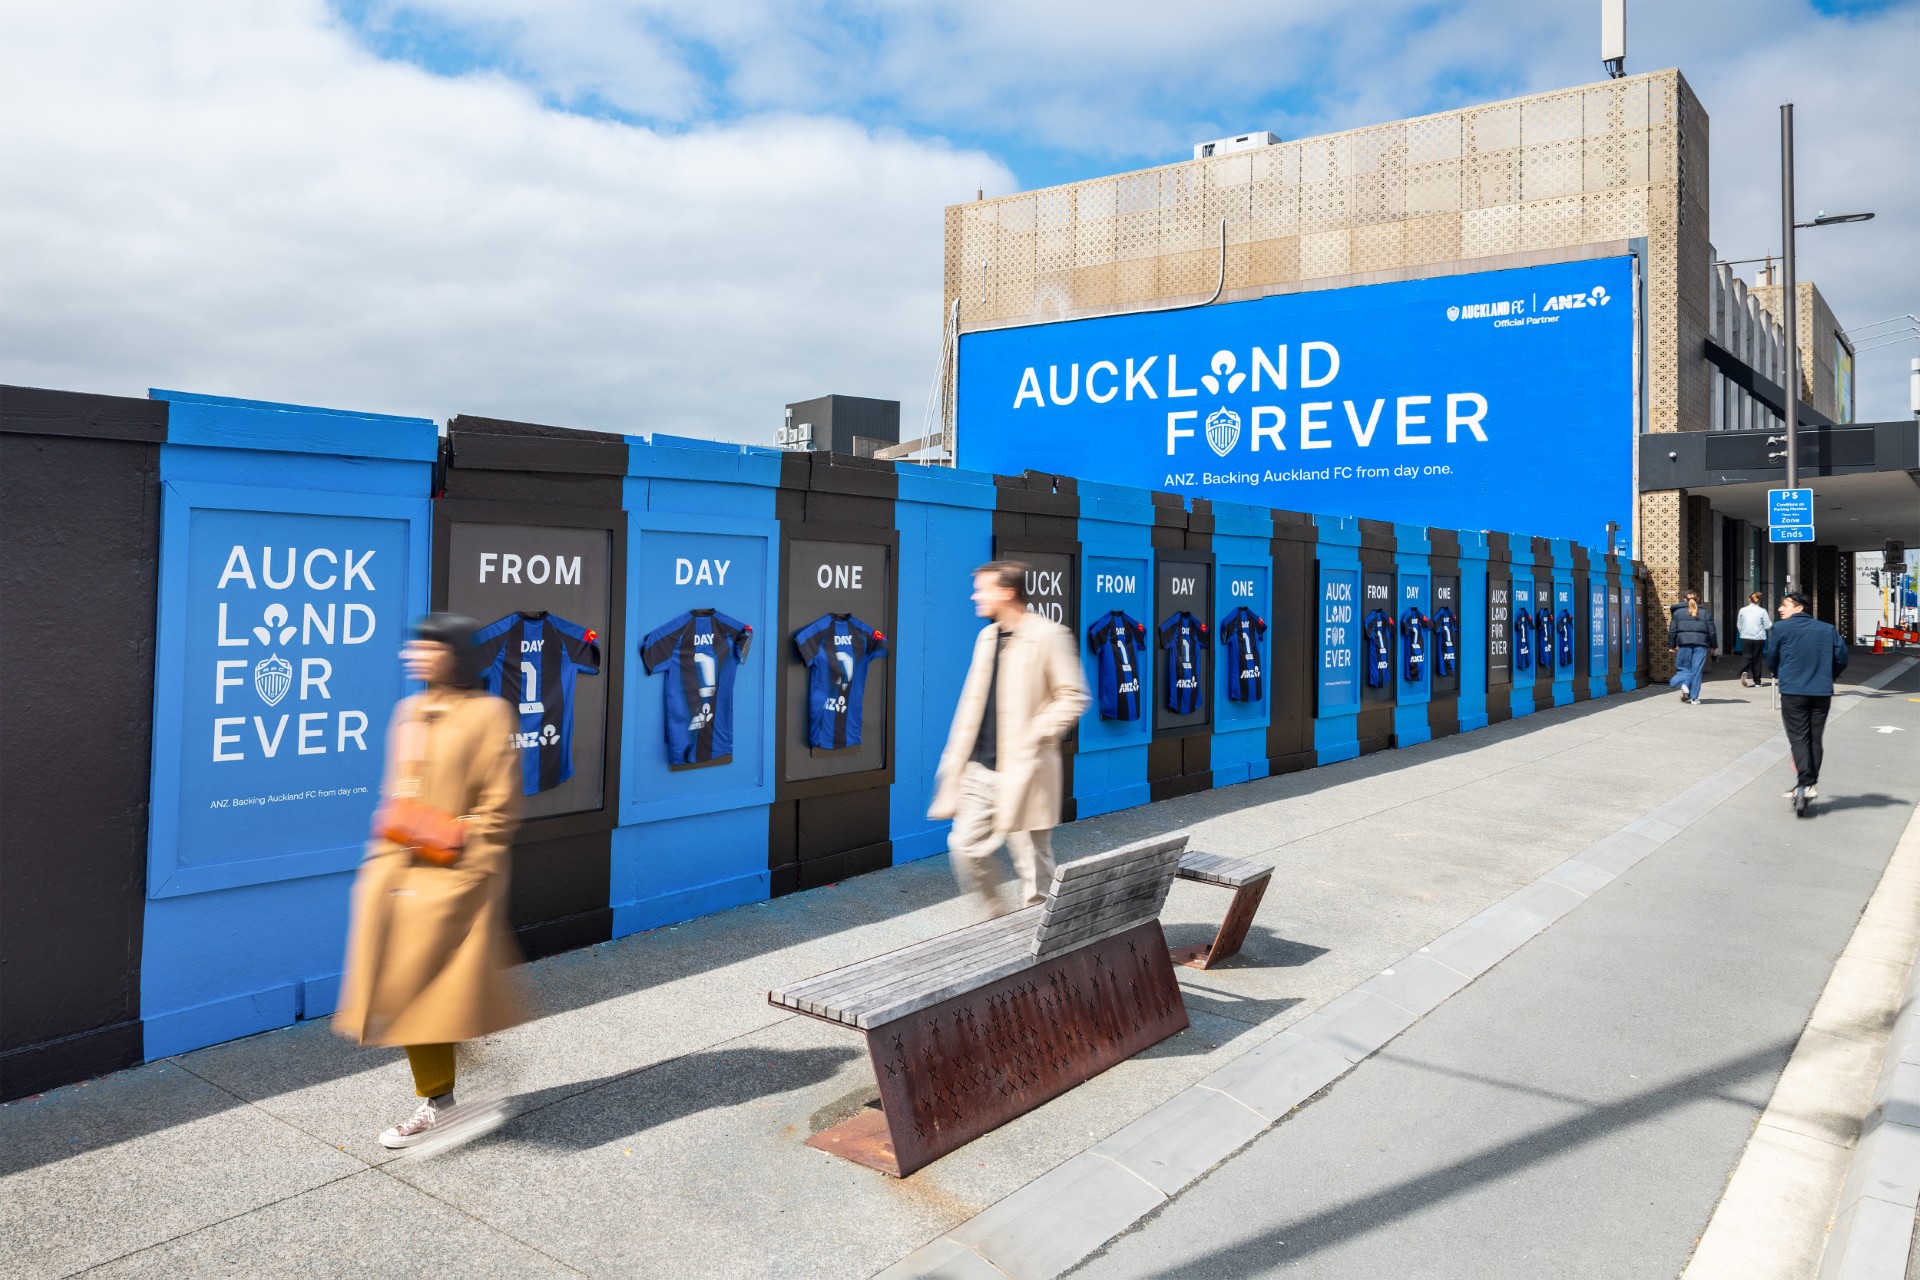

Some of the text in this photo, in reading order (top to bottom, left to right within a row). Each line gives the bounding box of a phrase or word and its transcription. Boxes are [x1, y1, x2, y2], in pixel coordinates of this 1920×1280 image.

[1462, 300, 1524, 319] AUCKLAND FC
[1542, 293, 1586, 312] ANZ
[1494, 316, 1560, 328] Official Partner
[1164, 464, 1454, 486] ANZ. Backing Auckland FC from day one.
[217, 545, 376, 591] AUCK
[479, 553, 582, 586] FROM
[675, 558, 730, 586] DAY
[816, 564, 863, 590] ONE
[1024, 570, 1062, 596] UCK
[1096, 574, 1136, 594] FROM
[1172, 578, 1196, 595] DAY
[1232, 580, 1254, 596] ONE
[1326, 583, 1352, 601] AUCK
[1368, 585, 1388, 599] FROM
[1407, 586, 1419, 599] DAY
[1438, 587, 1451, 599] ONE
[1492, 590, 1507, 603] AUCK
[1516, 591, 1528, 601] FROM
[520, 640, 544, 653] DAY
[694, 634, 714, 645] DAY
[834, 635, 852, 645] DAY
[1492, 641, 1507, 655] EVER
[1325, 649, 1351, 668] EVER
[1240, 670, 1254, 678] ANZ
[1119, 682, 1134, 693] ANZ
[1176, 679, 1191, 688] ANZ
[212, 711, 368, 762] EVER
[210, 800, 230, 808] ANZ.
[232, 796, 265, 806] Backing
[268, 792, 304, 803] Auckland
[305, 790, 316, 799] FC
[318, 789, 336, 797] from
[338, 788, 351, 797] day
